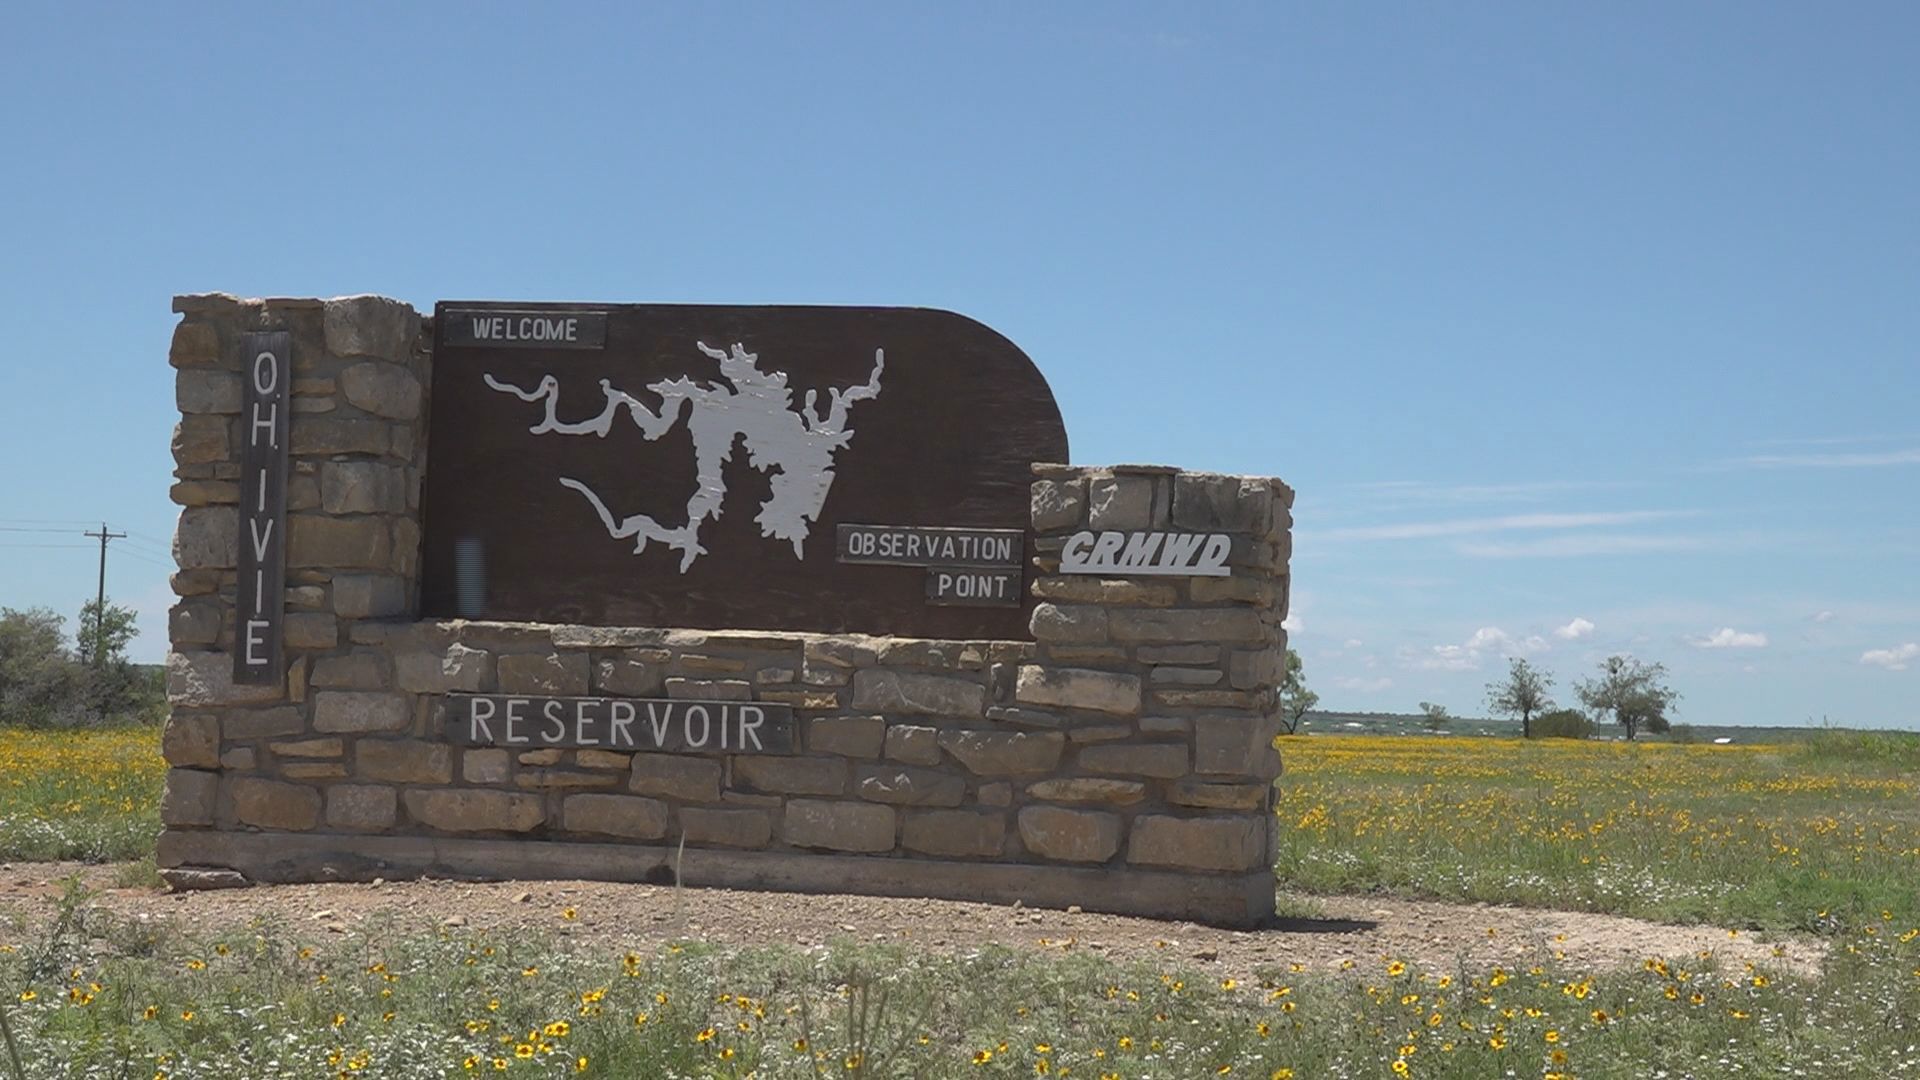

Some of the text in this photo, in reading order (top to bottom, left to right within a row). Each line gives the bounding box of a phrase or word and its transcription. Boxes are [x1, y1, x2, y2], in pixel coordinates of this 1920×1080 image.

[472, 317, 578, 341] WELCOME
[848, 531, 1012, 561] OBSERVATION
[1059, 530, 1232, 576] CRMWD
[937, 574, 1008, 599] POINT
[470, 697, 765, 750] RESERVOIR
